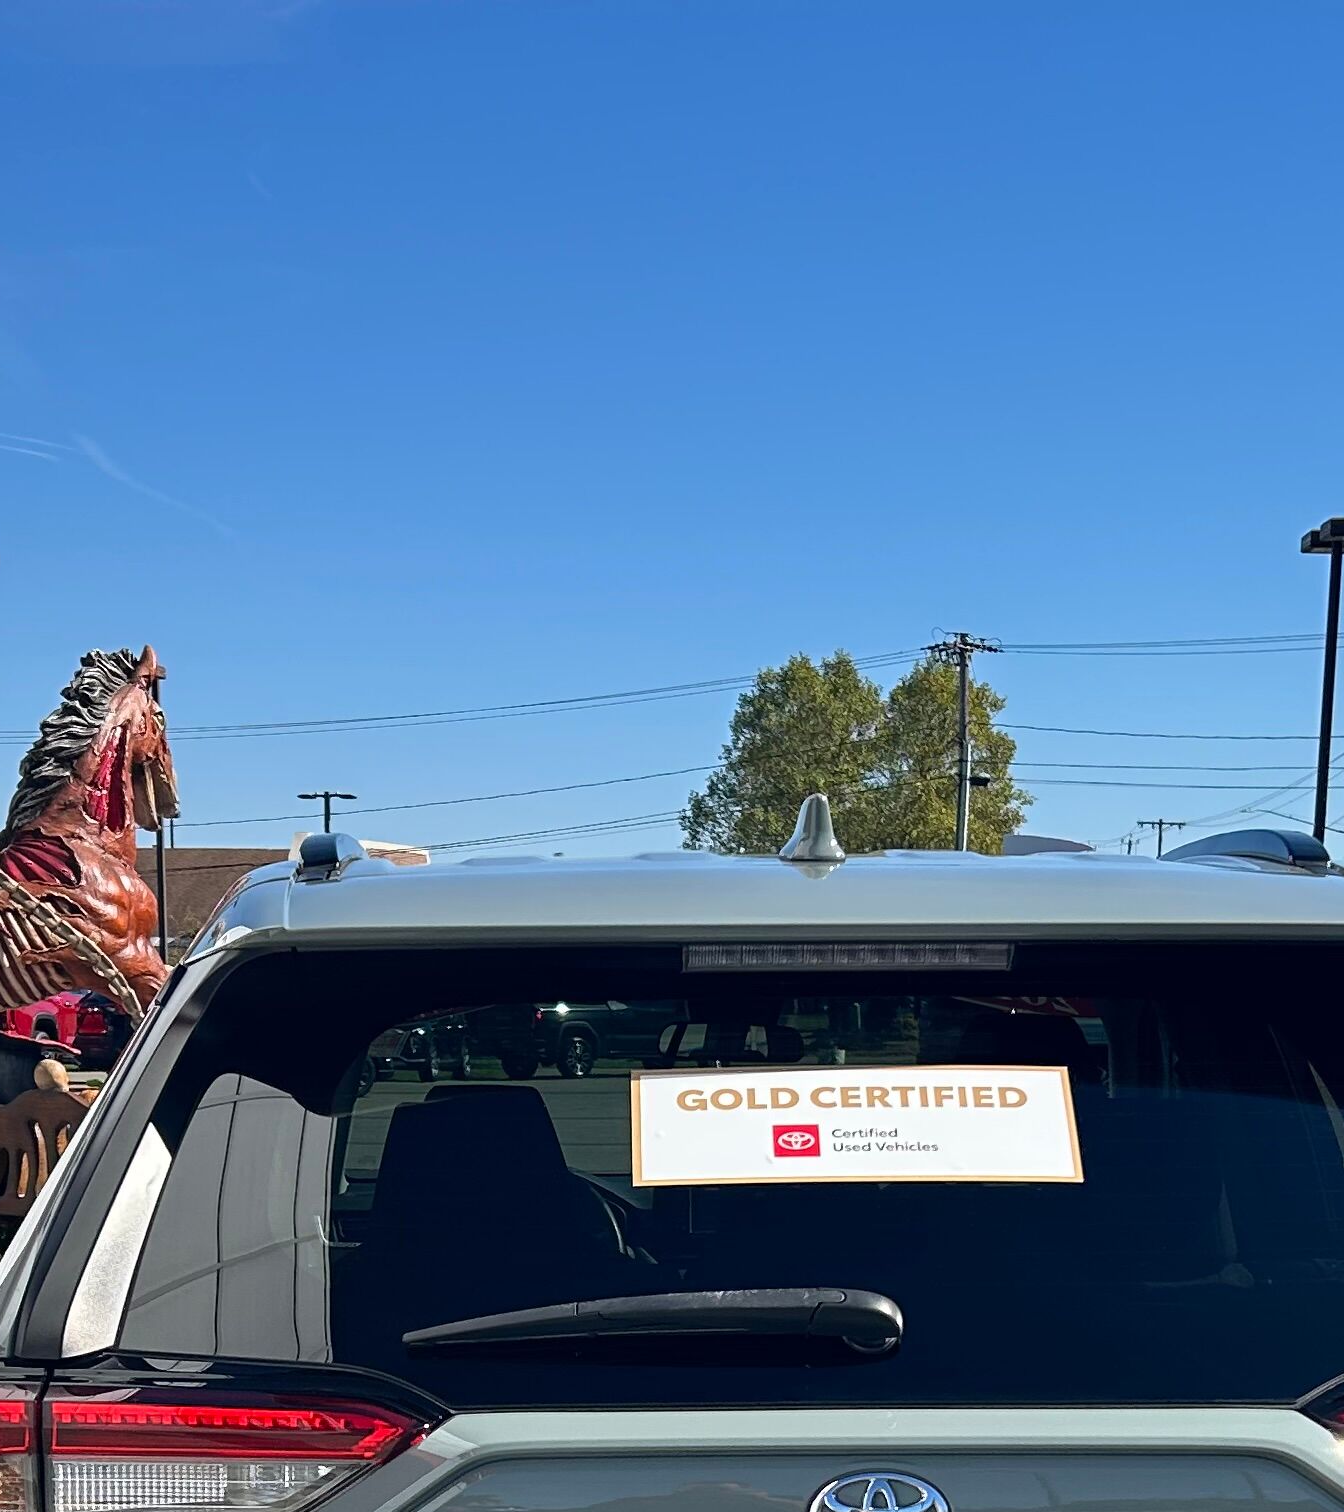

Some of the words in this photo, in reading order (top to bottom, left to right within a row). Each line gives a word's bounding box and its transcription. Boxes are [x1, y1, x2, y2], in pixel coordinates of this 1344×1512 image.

[676, 1086, 800, 1111] GOLD
[809, 1086, 1029, 1109] CERTIFIED
[831, 1128, 898, 1139] Certified
[833, 1141, 872, 1152] Used
[875, 1141, 939, 1152] Vehicles
